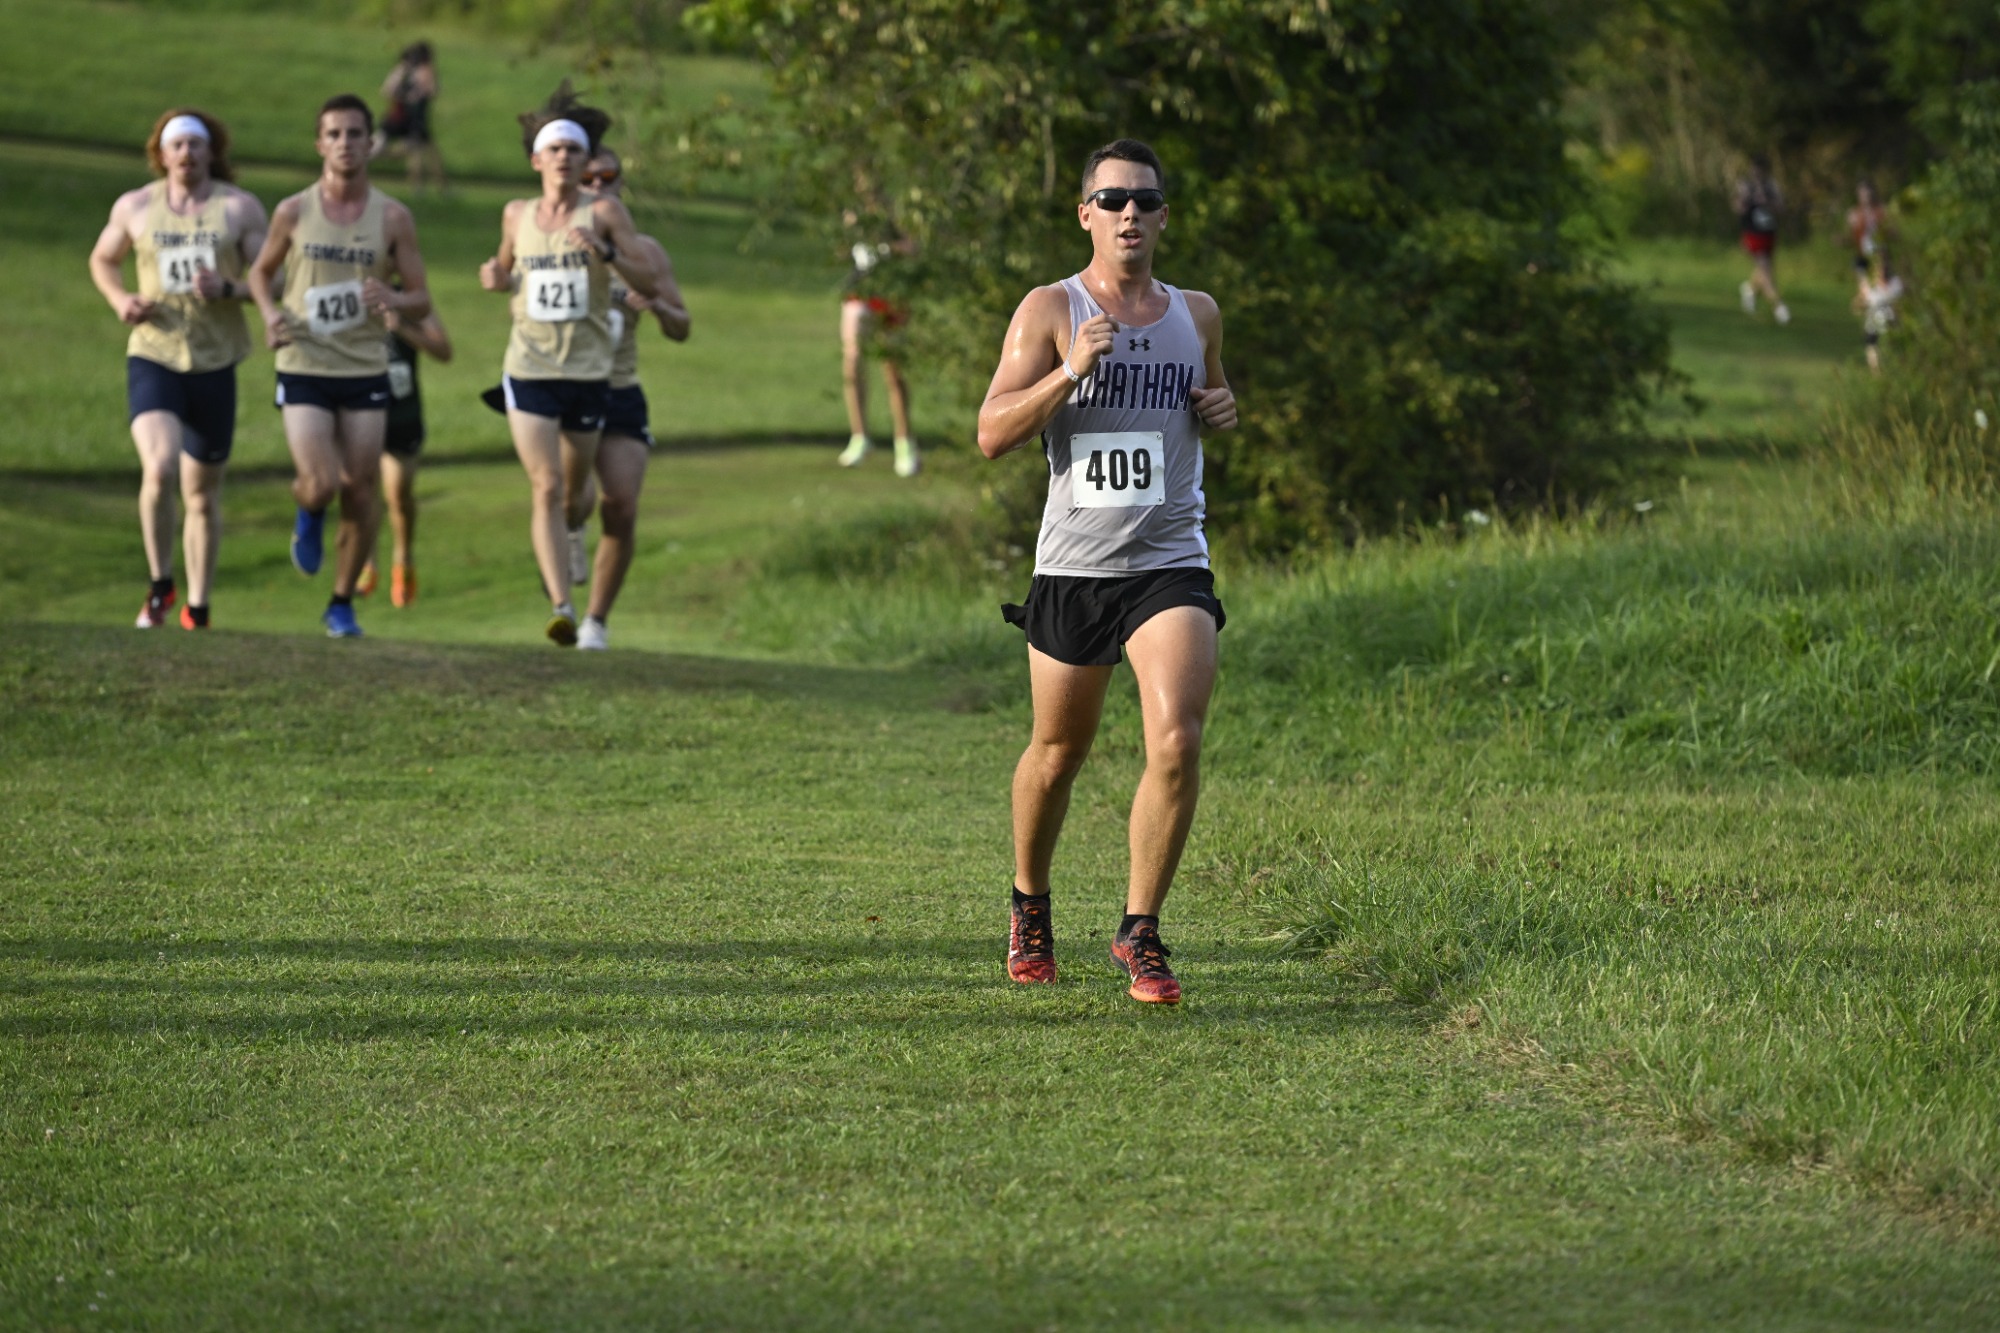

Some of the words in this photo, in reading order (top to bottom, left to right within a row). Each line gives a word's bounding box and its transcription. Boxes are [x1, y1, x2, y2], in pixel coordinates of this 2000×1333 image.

[316, 291, 359, 325] 420
[537, 281, 579, 309] 421
[1085, 448, 1152, 491] 409
